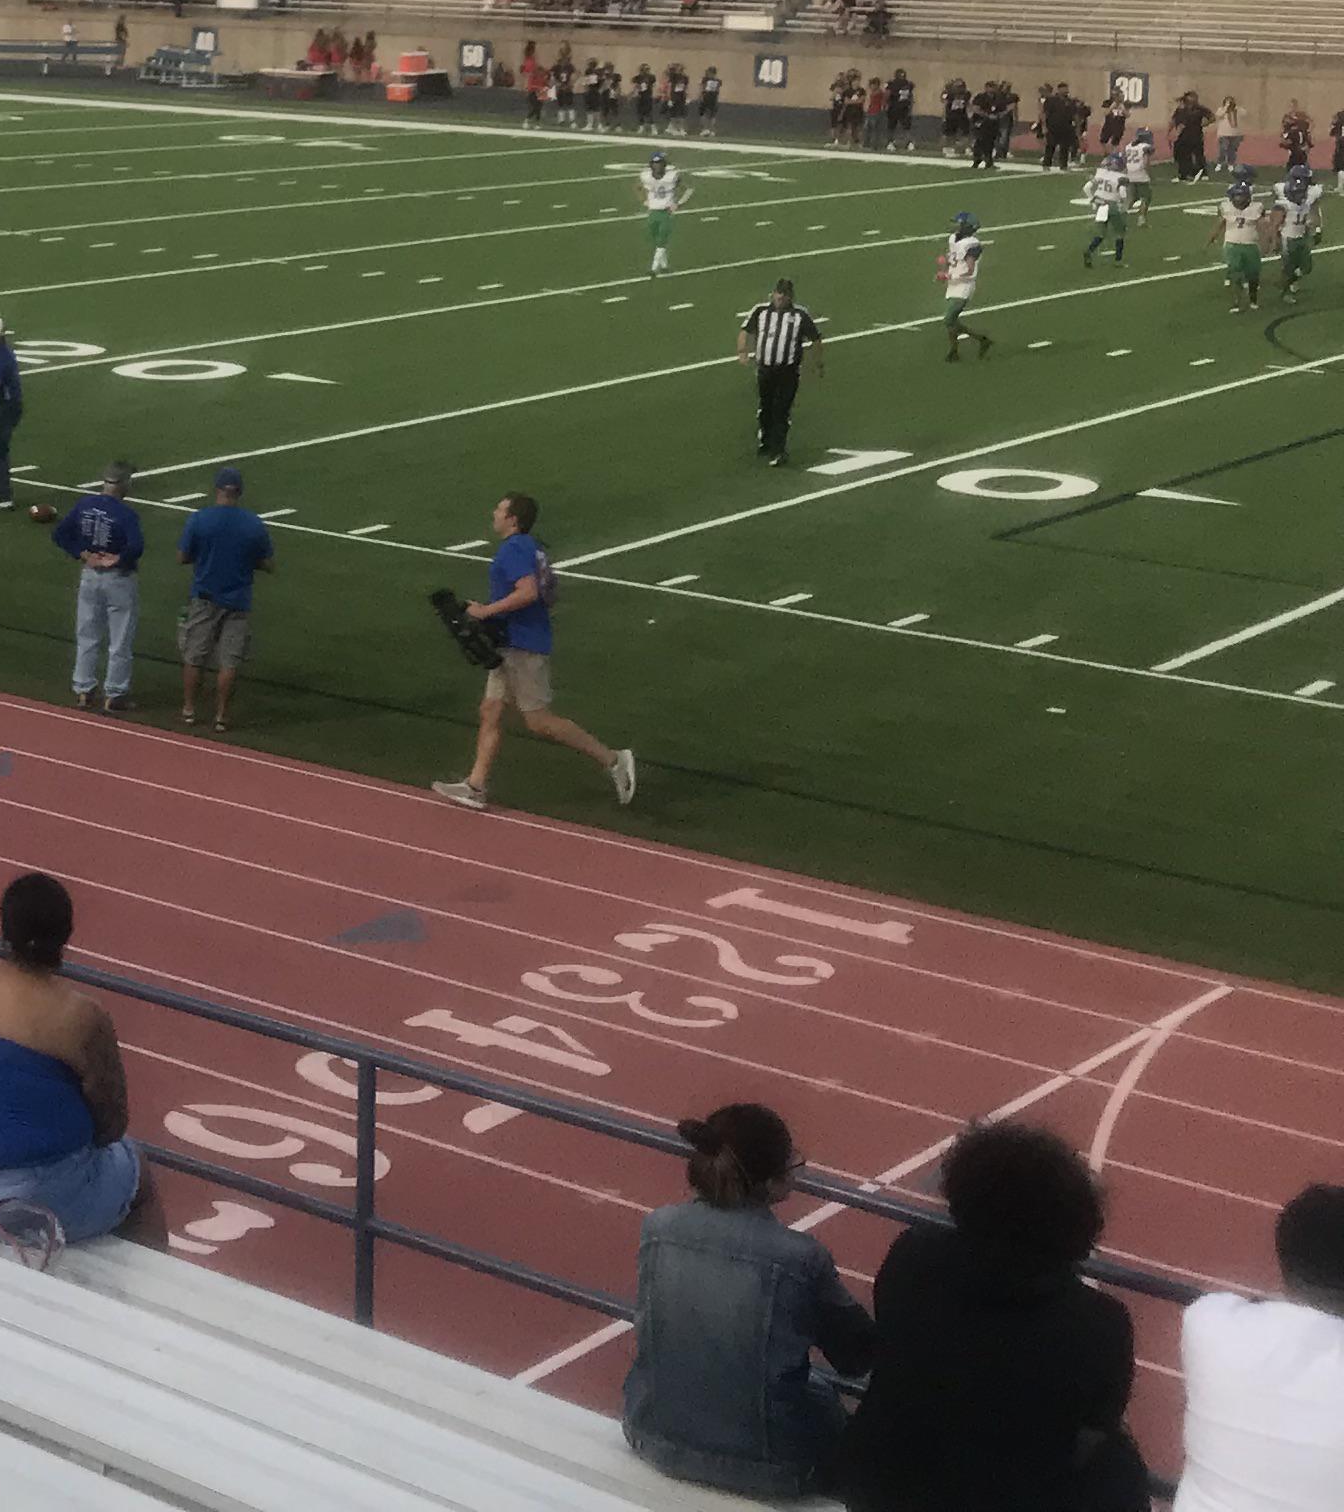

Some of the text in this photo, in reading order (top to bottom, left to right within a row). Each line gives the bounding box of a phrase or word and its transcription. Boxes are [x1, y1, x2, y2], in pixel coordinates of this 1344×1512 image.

[1115, 77, 1143, 103] 30
[806, 447, 1100, 501] 10
[706, 888, 914, 945] 1
[613, 923, 836, 986] 2
[520, 963, 739, 1029] 3
[403, 1008, 612, 1076] 4
[163, 1103, 392, 1187] 6
